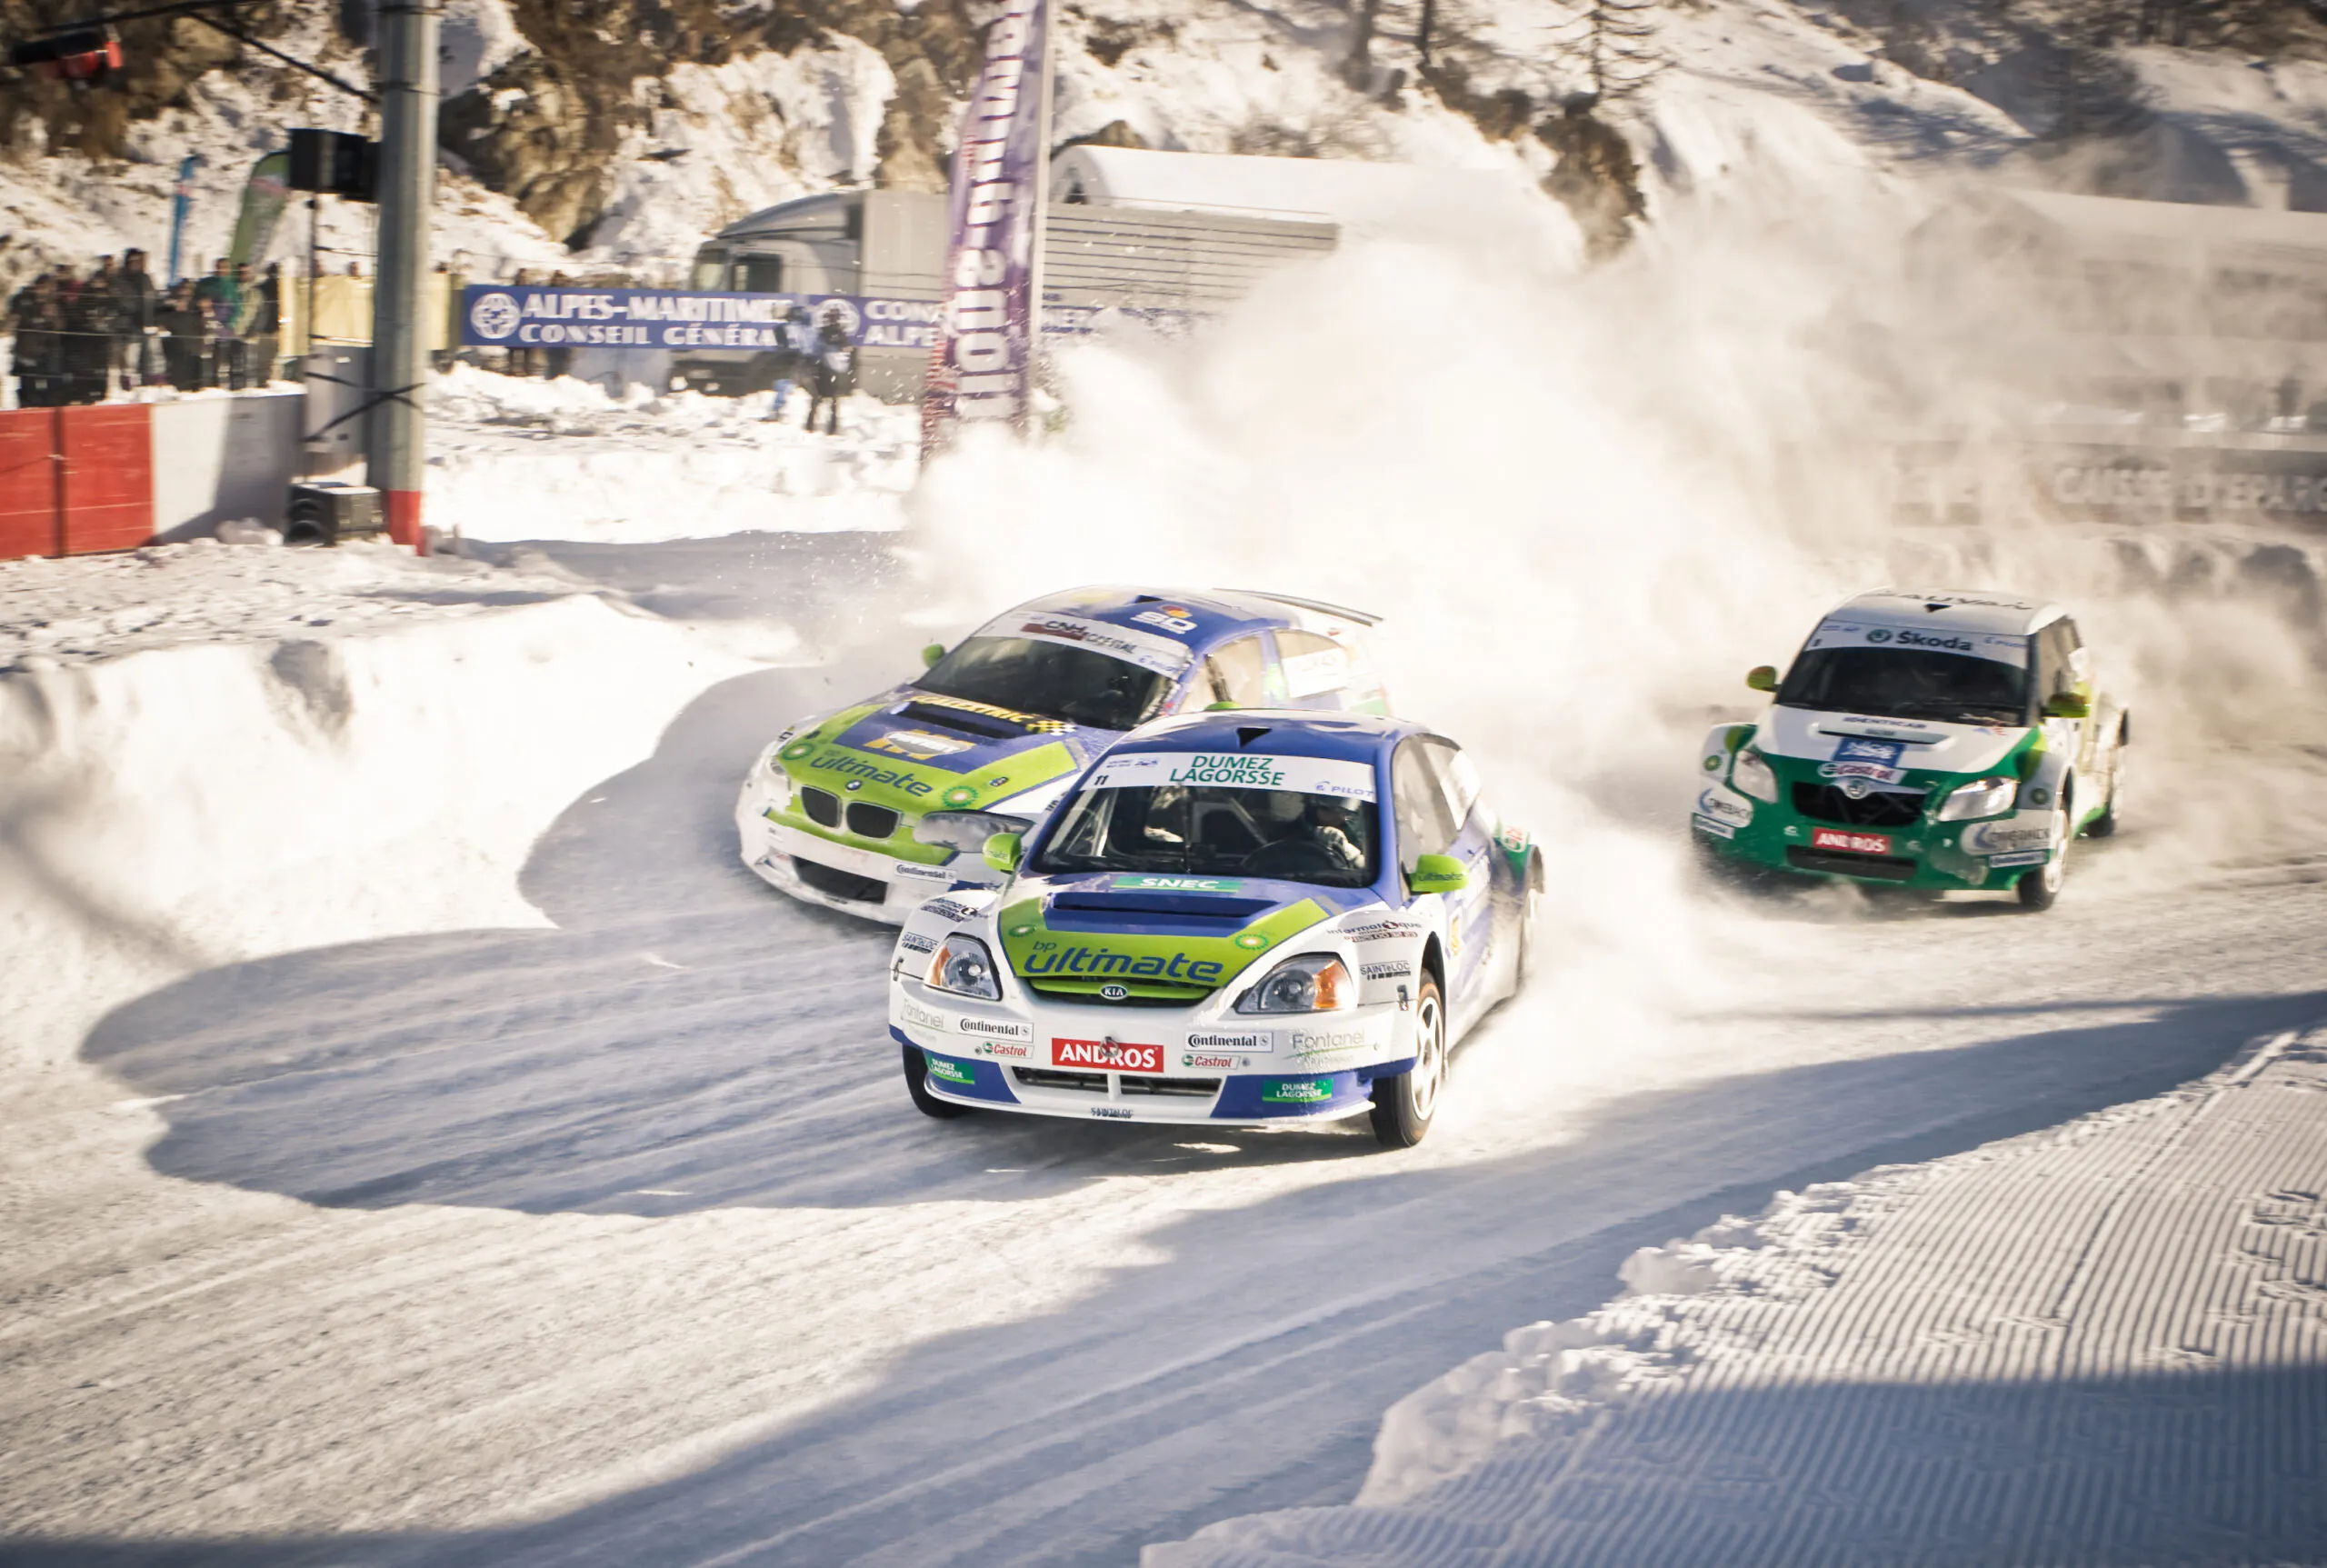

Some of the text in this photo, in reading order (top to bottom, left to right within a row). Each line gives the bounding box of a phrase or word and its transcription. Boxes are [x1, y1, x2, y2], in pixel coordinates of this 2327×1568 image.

[519, 322, 779, 346] CONSEIL GÉNÉRA
[1895, 631, 1972, 651] Škoda
[1192, 755, 1273, 771] DUMEZ
[811, 756, 934, 797] ultimate
[1169, 769, 1285, 786] LAGORSSE
[1140, 878, 1220, 889] SNEC
[1033, 941, 1057, 952] bp
[1024, 947, 1223, 983] ultimate
[1104, 987, 1124, 997] KIA
[960, 1018, 1019, 1035] Continental
[1188, 1034, 1257, 1047] Continental
[994, 1044, 1027, 1056] Castrol
[1060, 1044, 1155, 1068] ANDROS
[1194, 1055, 1232, 1067] Castrol
